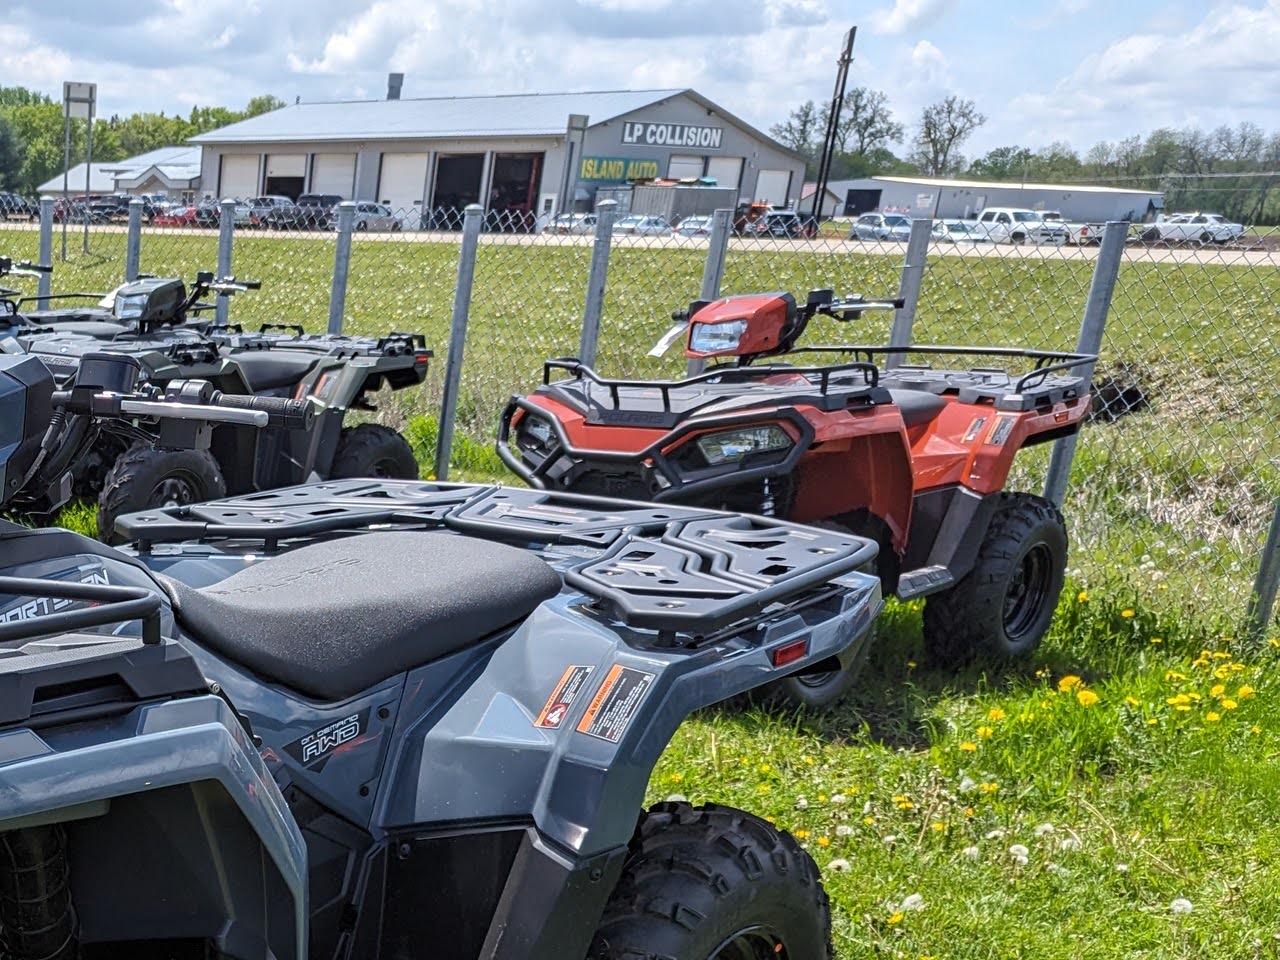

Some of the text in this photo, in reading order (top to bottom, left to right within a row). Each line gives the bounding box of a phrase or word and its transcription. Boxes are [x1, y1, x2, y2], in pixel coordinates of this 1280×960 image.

[623, 122, 722, 147] LP COLLISION
[581, 159, 659, 180] ISLAND AUTO
[592, 680, 612, 710] WARNING
[317, 714, 359, 737] DEMAND
[302, 721, 360, 762] AWD
